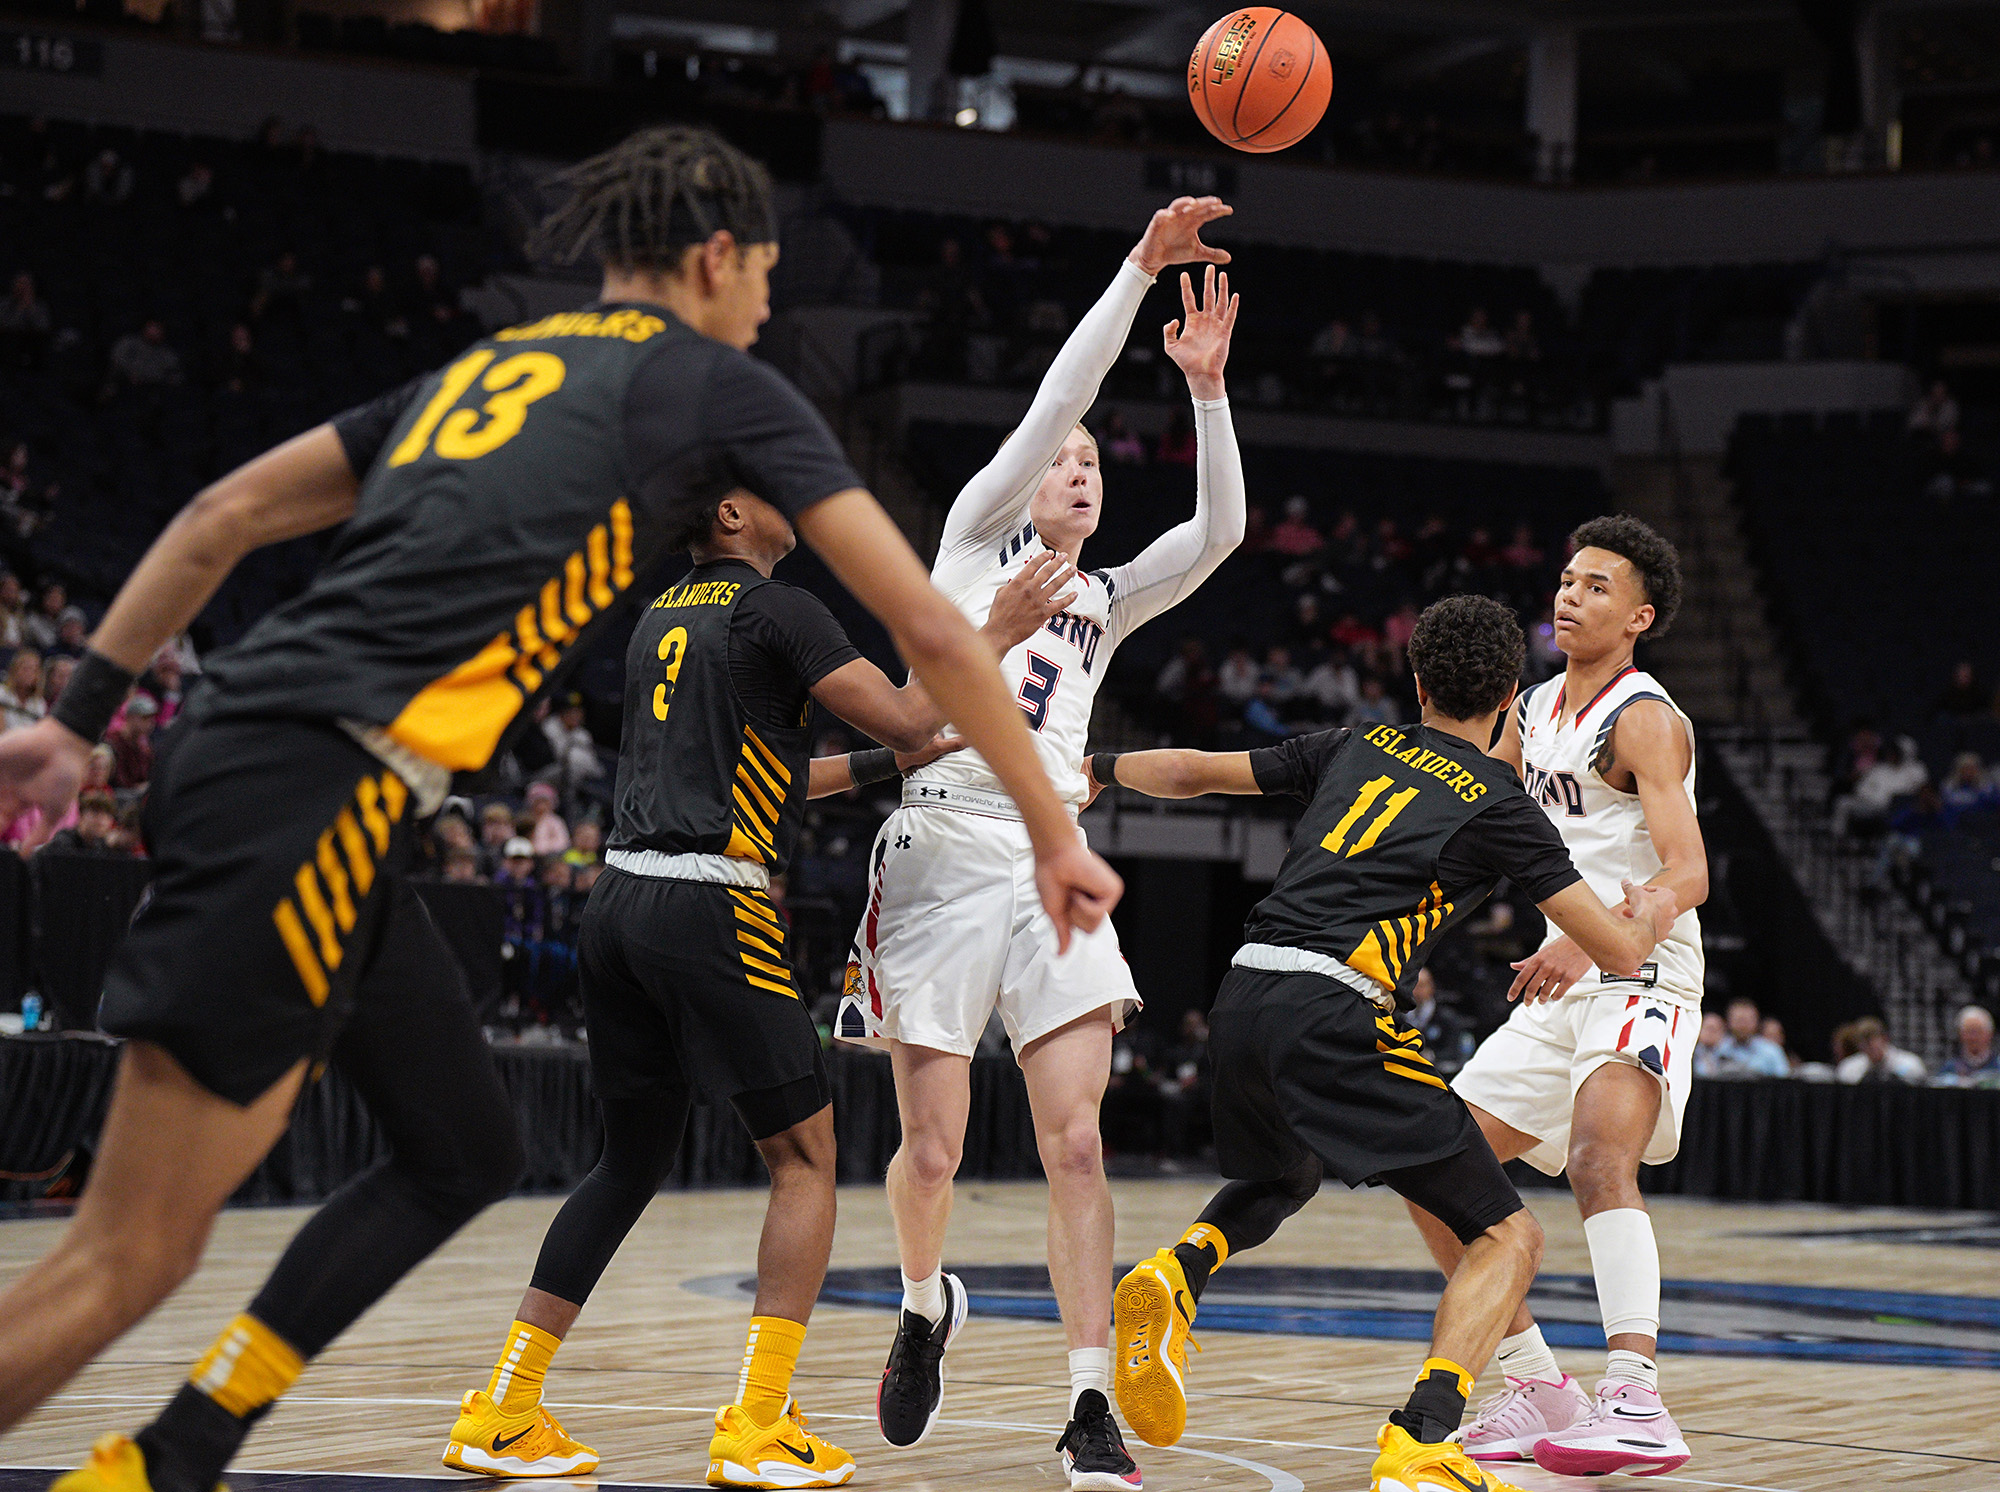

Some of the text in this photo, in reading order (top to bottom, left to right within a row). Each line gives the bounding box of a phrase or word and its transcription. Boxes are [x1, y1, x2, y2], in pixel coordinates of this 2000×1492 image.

[1210, 14, 1251, 86] LEGACY
[388, 349, 567, 469] 13
[651, 581, 741, 609] ISLANDERS
[652, 626, 688, 721] 3
[1016, 649, 1063, 735] 3
[1363, 724, 1488, 803] ISLANDERS
[1319, 774, 1421, 859] 11
